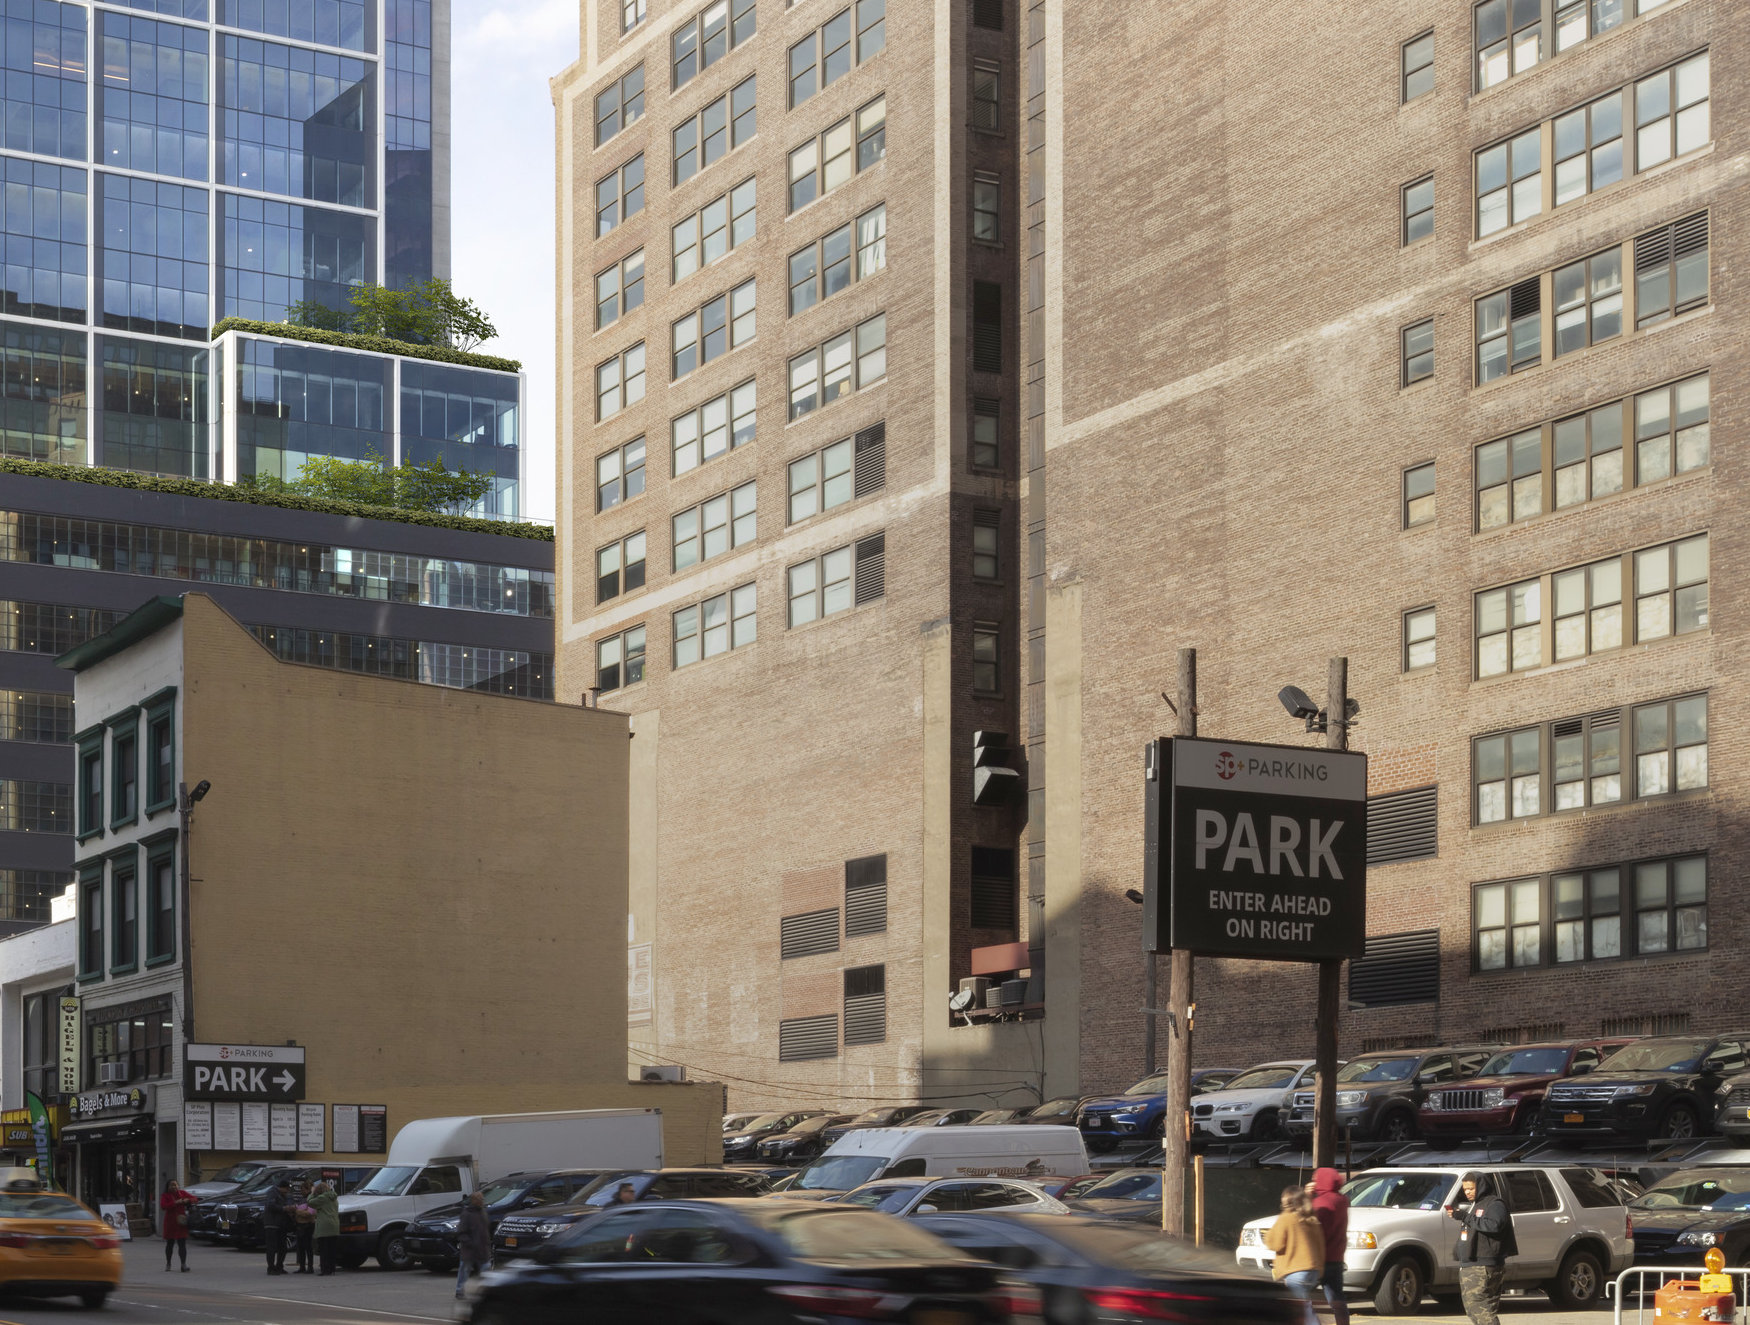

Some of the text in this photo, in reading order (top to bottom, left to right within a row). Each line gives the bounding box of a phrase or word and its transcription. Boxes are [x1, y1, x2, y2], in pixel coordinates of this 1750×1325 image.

[1249, 758, 1328, 781] PARKING
[1195, 808, 1345, 880] PARK
[1209, 890, 1332, 916] ENTER AHEAD
[1226, 918, 1315, 941] ON RIGHT
[64, 1015, 74, 1052] BAGELS
[235, 1049, 274, 1058] PARKING
[64, 1067, 74, 1091] MORE
[195, 1066, 268, 1092] PARK
[79, 1095, 103, 1115] Bagels
[104, 1094, 110, 1107] &
[110, 1093, 128, 1106] More
[8, 1130, 35, 1140] SUBW
